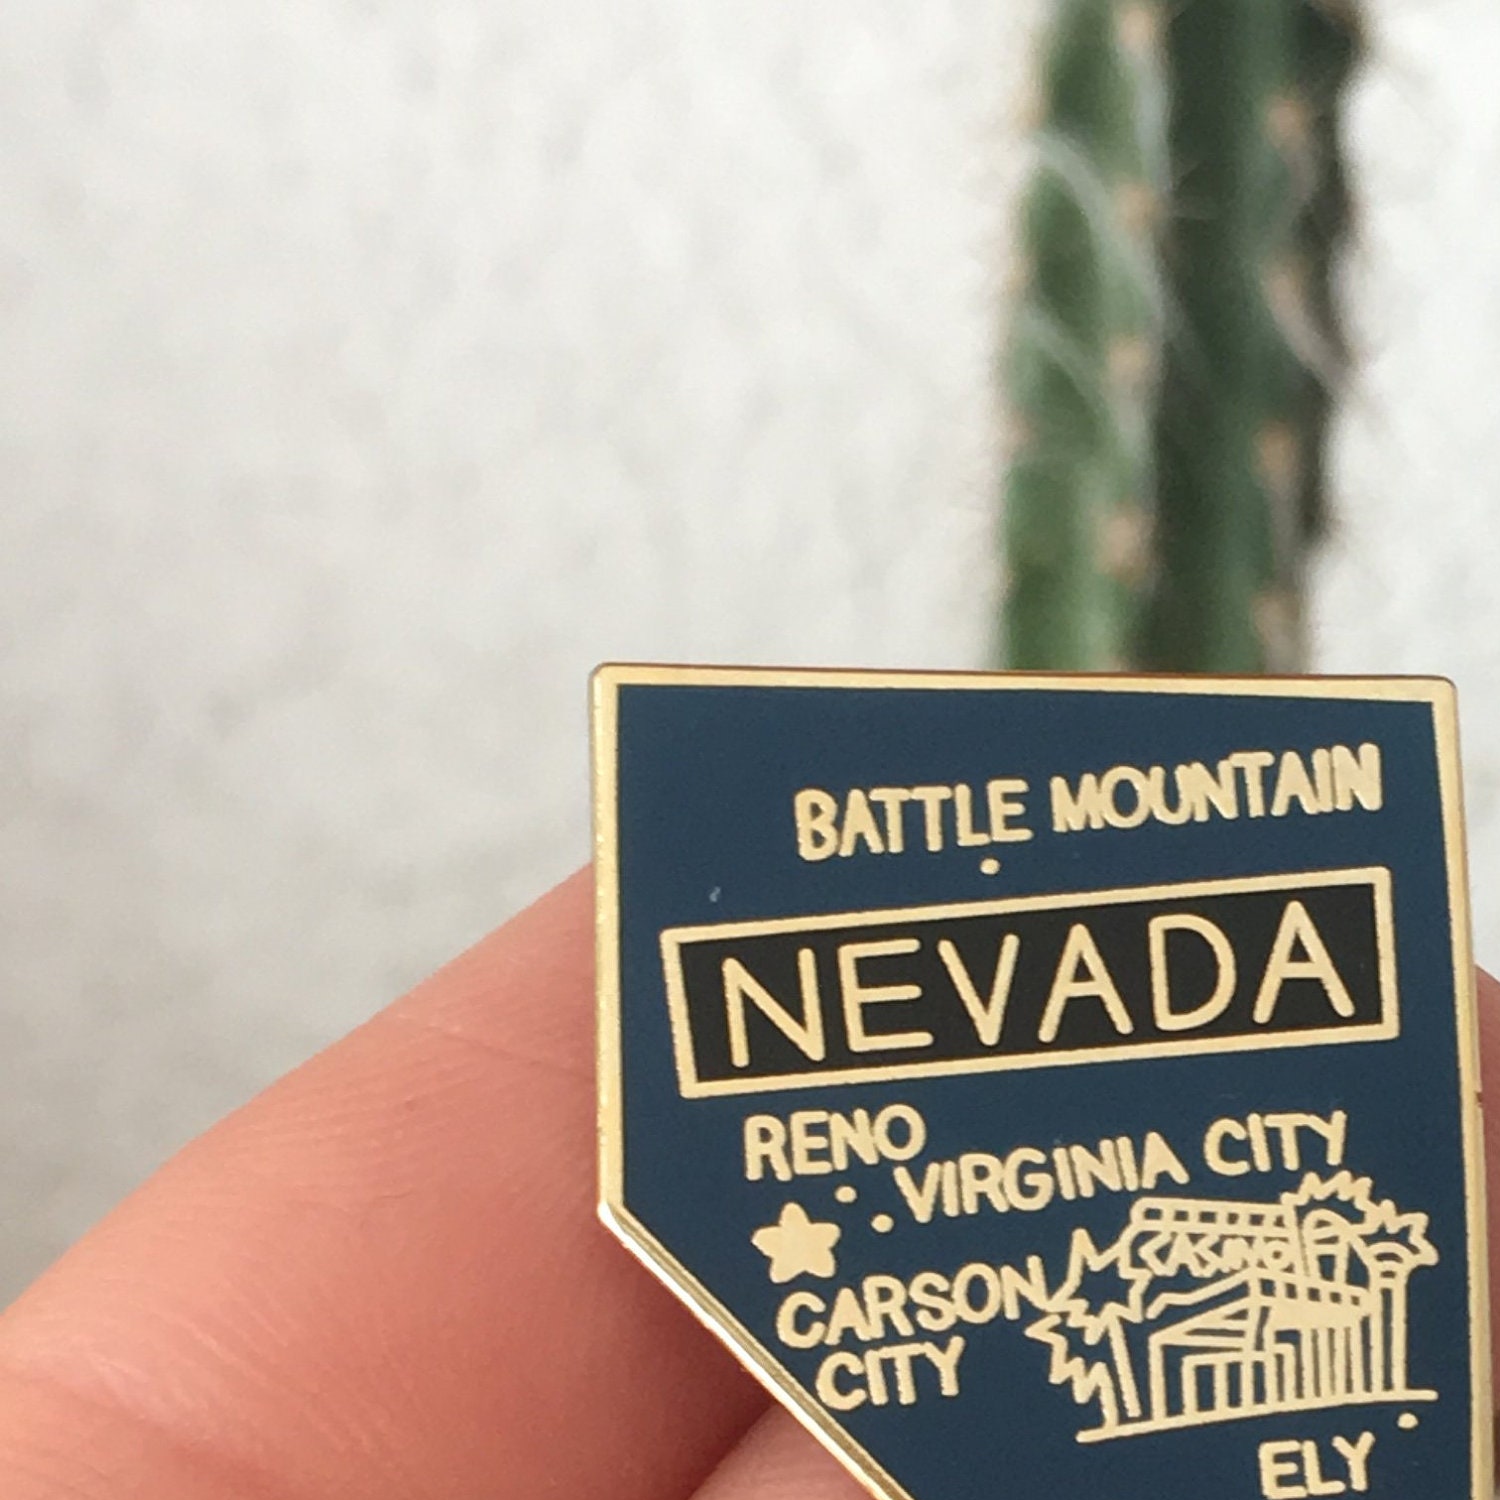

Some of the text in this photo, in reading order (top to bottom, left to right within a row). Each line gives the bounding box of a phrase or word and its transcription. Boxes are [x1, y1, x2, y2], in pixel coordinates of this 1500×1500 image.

[793, 742, 1383, 861] BATTLE MOUNTAIN
[722, 900, 1355, 1068] NEVADA
[743, 1103, 926, 1182] RENO
[892, 1109, 1347, 1224] VIRGINIA CITY
[776, 1255, 1048, 1349] CARSON
[814, 1335, 965, 1411] CITY
[1257, 1431, 1376, 1500] ELY
